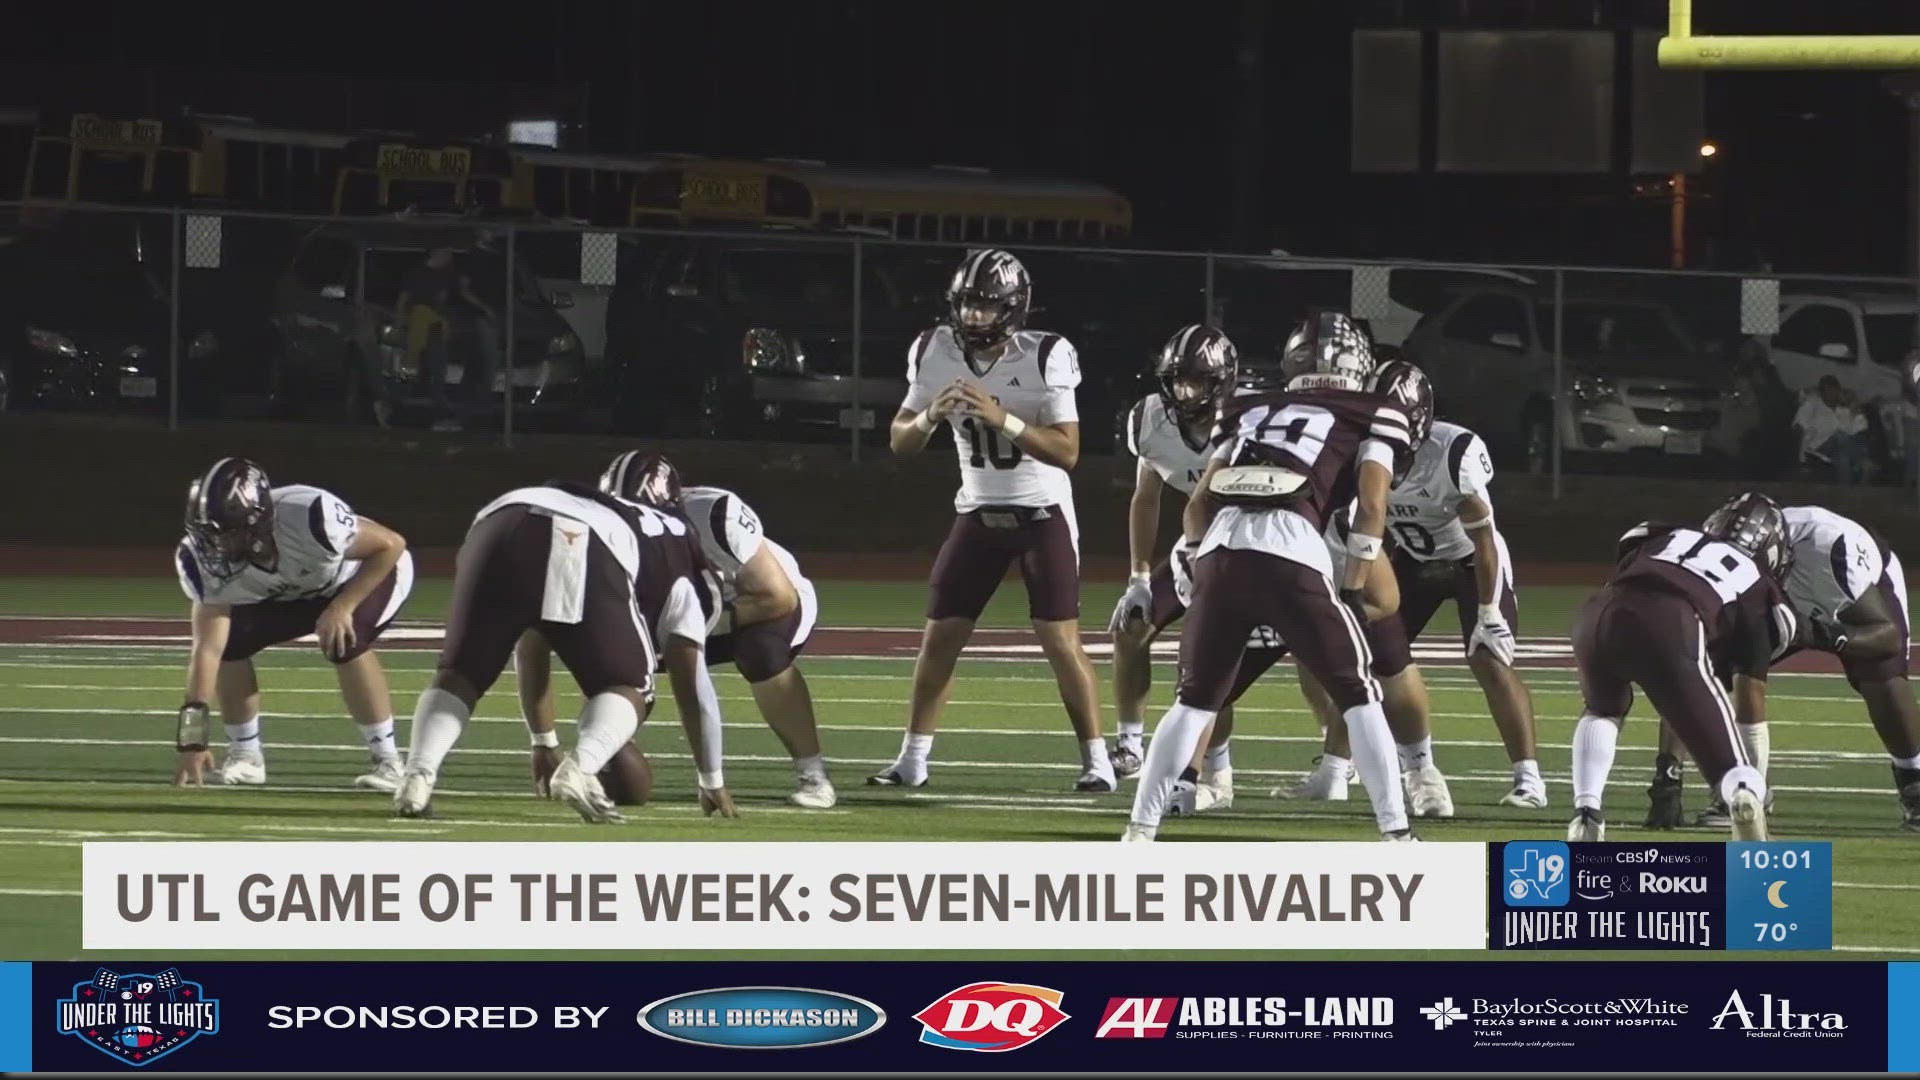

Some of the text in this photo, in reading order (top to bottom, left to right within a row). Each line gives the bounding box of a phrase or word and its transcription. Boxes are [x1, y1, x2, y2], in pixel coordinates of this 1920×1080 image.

[131, 123, 158, 141] BUS
[382, 149, 466, 172] SCHOOL BUS
[688, 180, 760, 202] SCHOOL BUS
[1301, 376, 1347, 389] Riddell
[961, 416, 1023, 470] 10
